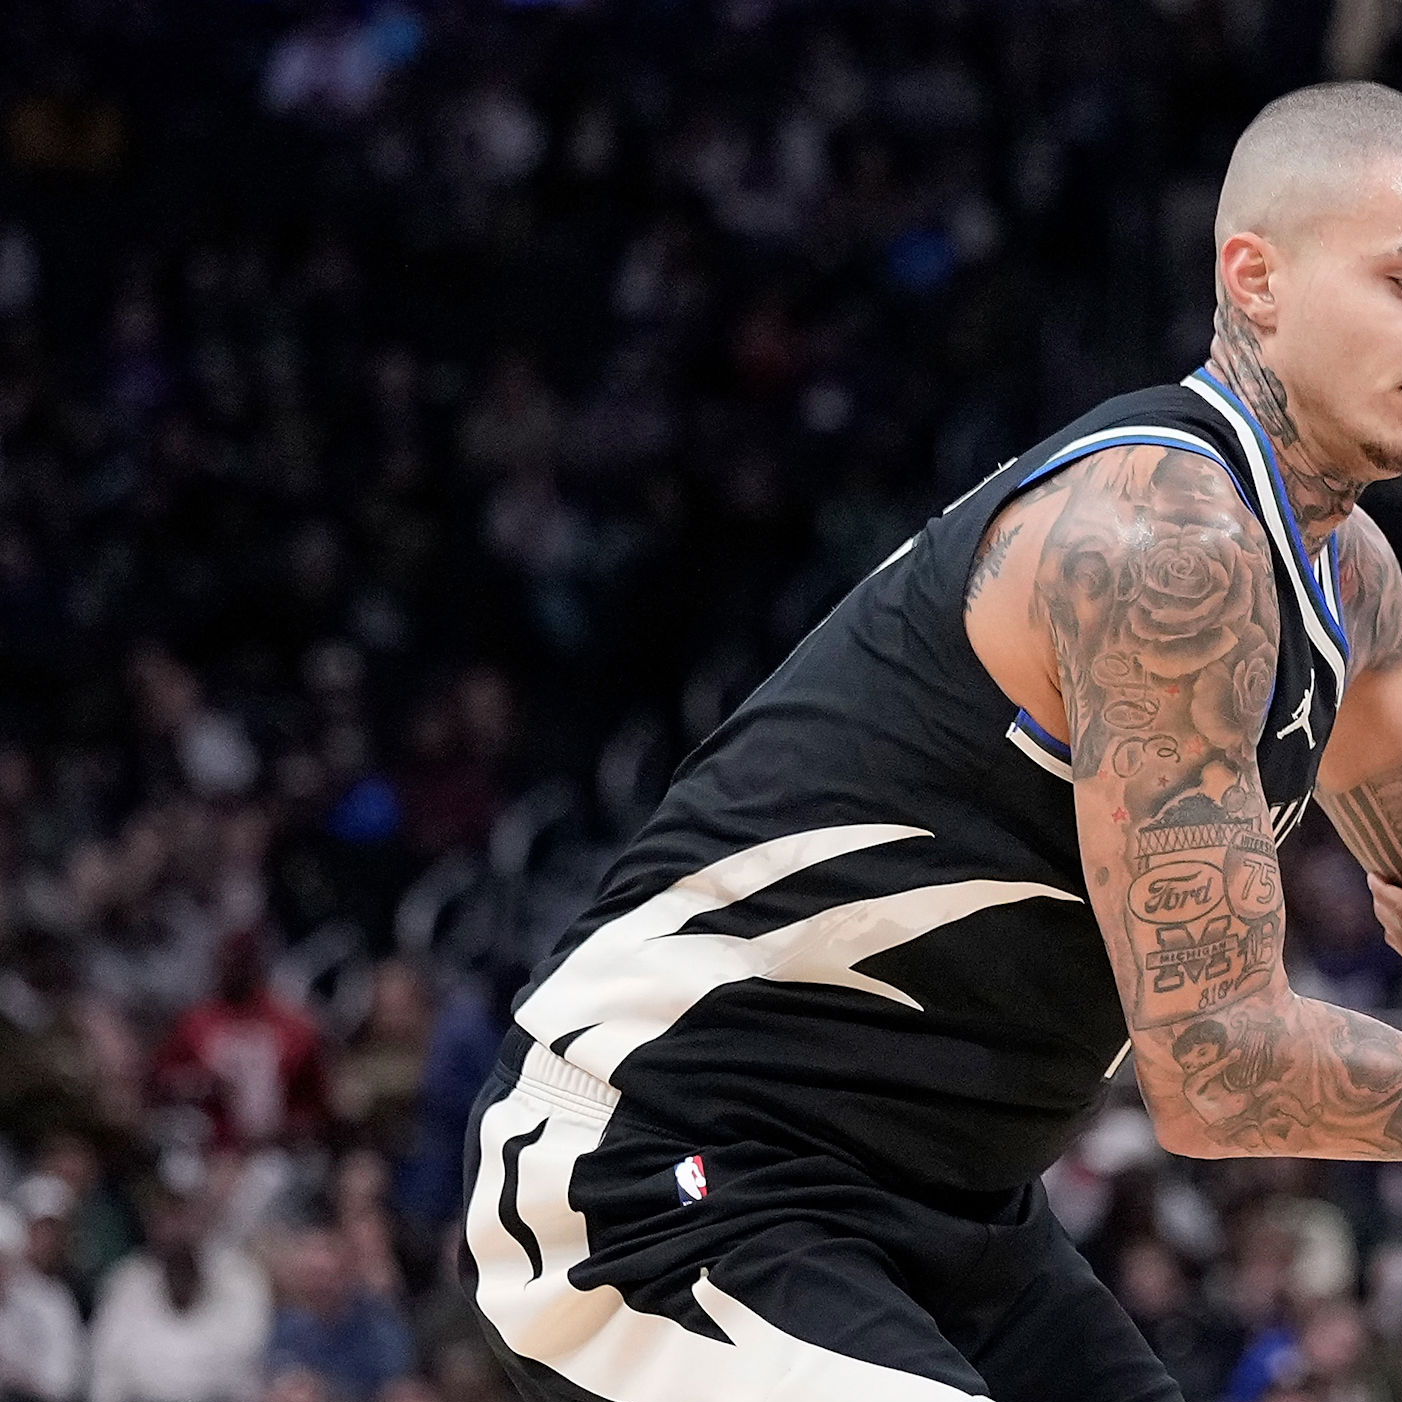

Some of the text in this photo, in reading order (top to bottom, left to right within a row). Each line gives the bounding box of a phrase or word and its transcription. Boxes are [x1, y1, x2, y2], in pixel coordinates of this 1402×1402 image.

[1144, 870, 1213, 914] Ford
[1241, 859, 1277, 904] 75
[1159, 940, 1228, 964] MICHIGAN
